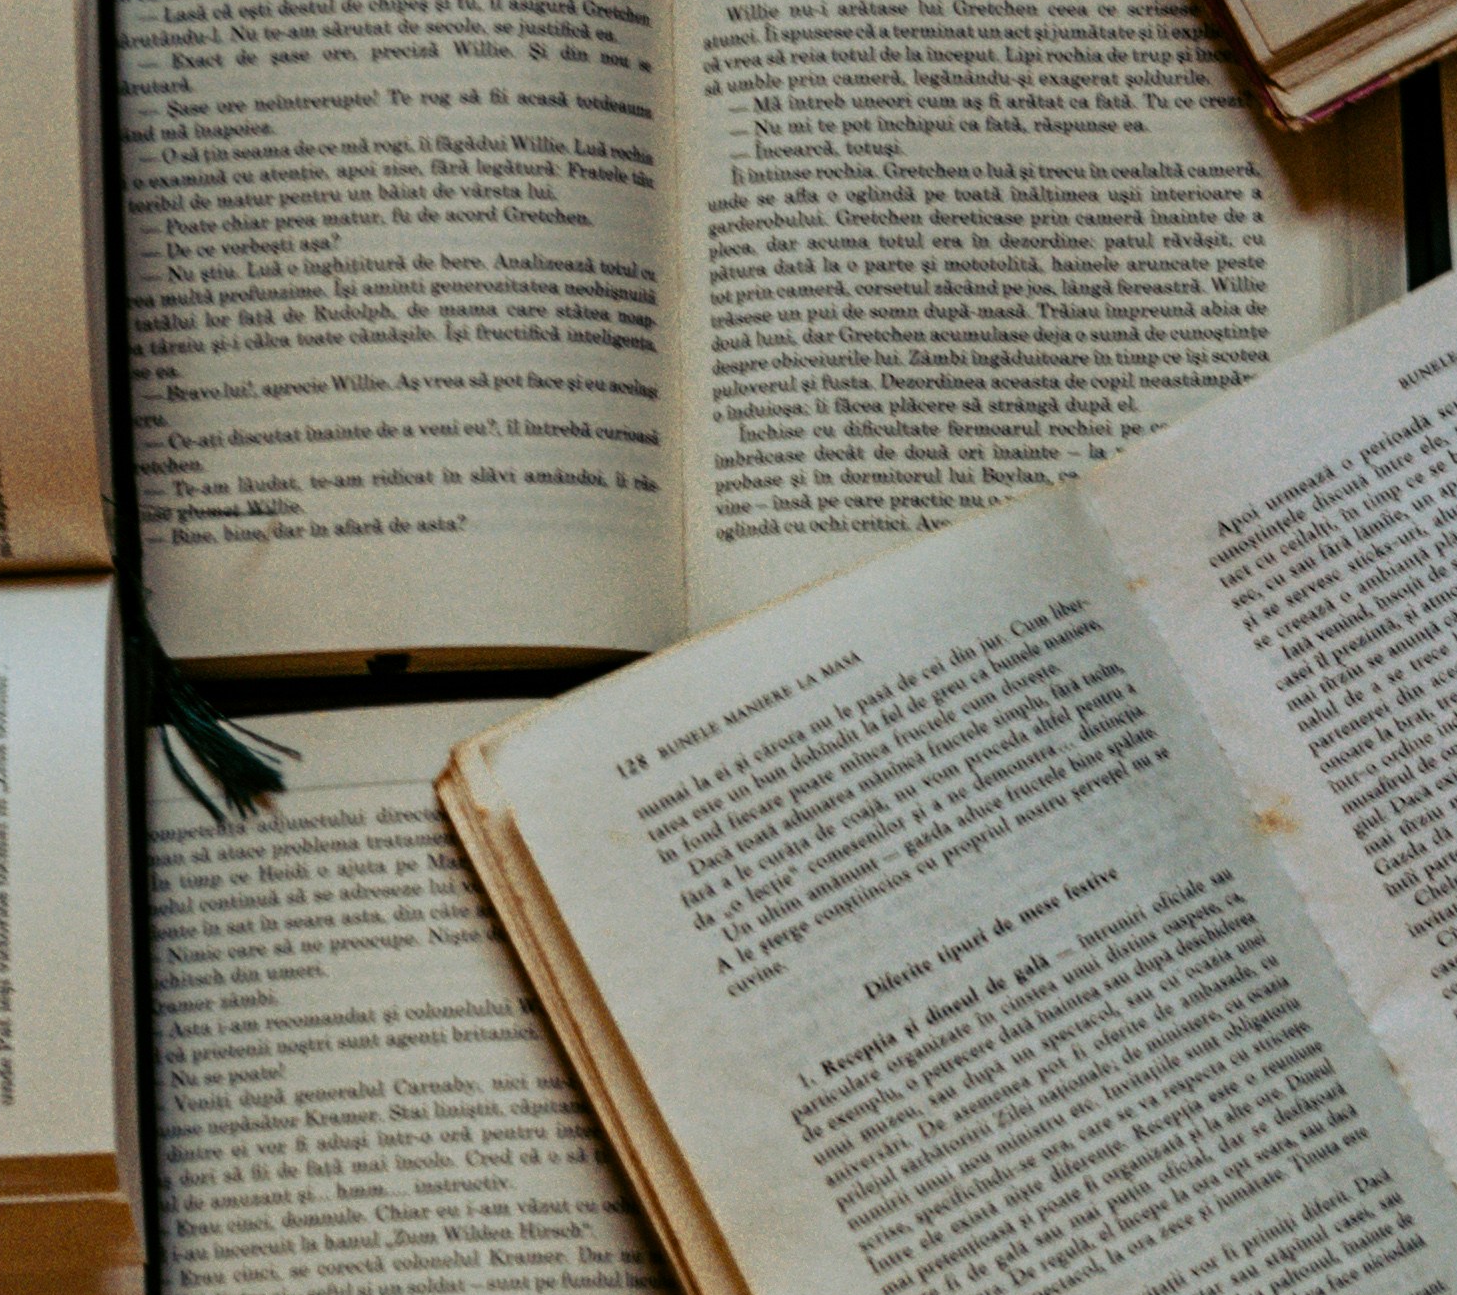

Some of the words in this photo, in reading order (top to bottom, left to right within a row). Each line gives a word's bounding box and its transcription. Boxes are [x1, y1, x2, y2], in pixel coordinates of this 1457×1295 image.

[752, 95, 783, 114] Mă
[787, 92, 847, 112] întreb
[850, 96, 913, 110] uneori
[915, 95, 958, 110] cum
[961, 96, 984, 113] aș
[987, 91, 1002, 110] fi
[1005, 92, 1065, 111] arătat
[1067, 97, 1091, 111] ca
[1094, 92, 1134, 111] fată.
[1142, 91, 1170, 111] Tu
[1173, 96, 1195, 110] ce
[753, 118, 783, 138] Nu
[787, 121, 813, 135] mi
[816, 118, 837, 134] te
[840, 117, 873, 137] pot
[876, 114, 955, 137] închipui
[957, 119, 981, 133] ca
[984, 114, 1029, 135] fată,
[1032, 116, 1119, 137] răspunse
[844, 140, 905, 160] totuși.
[1216, 507, 1261, 538] Apoi
[1263, 465, 1337, 512] urmează
[1340, 458, 1354, 472] o
[1358, 414, 1433, 467] perioadă
[1252, 634, 1272, 651] se
[1275, 597, 1338, 640] creează
[1338, 590, 1353, 605] o
[1357, 546, 1432, 595] ambianță
[615, 753, 650, 780] 128
[656, 721, 720, 761] BUNELE
[722, 685, 793, 727] MANIERE
[795, 673, 819, 691] LA
[726, 961, 787, 998] cuvine.
[797, 1073, 816, 1089] 1.
[819, 1032, 899, 1078] Recepția
[902, 1019, 921, 1041] și
[924, 985, 981, 1027] dineul
[984, 975, 1008, 996] de
[1012, 954, 1052, 987] gală
[1076, 909, 1148, 950] întruniri
[1151, 879, 1206, 915] oficiale
[1209, 868, 1235, 887] sau
[862, 959, 932, 1001] Diferite
[936, 929, 989, 965] tipuri
[991, 917, 1014, 938] de
[1017, 896, 1061, 925] mese
[1062, 867, 1119, 902] festive
